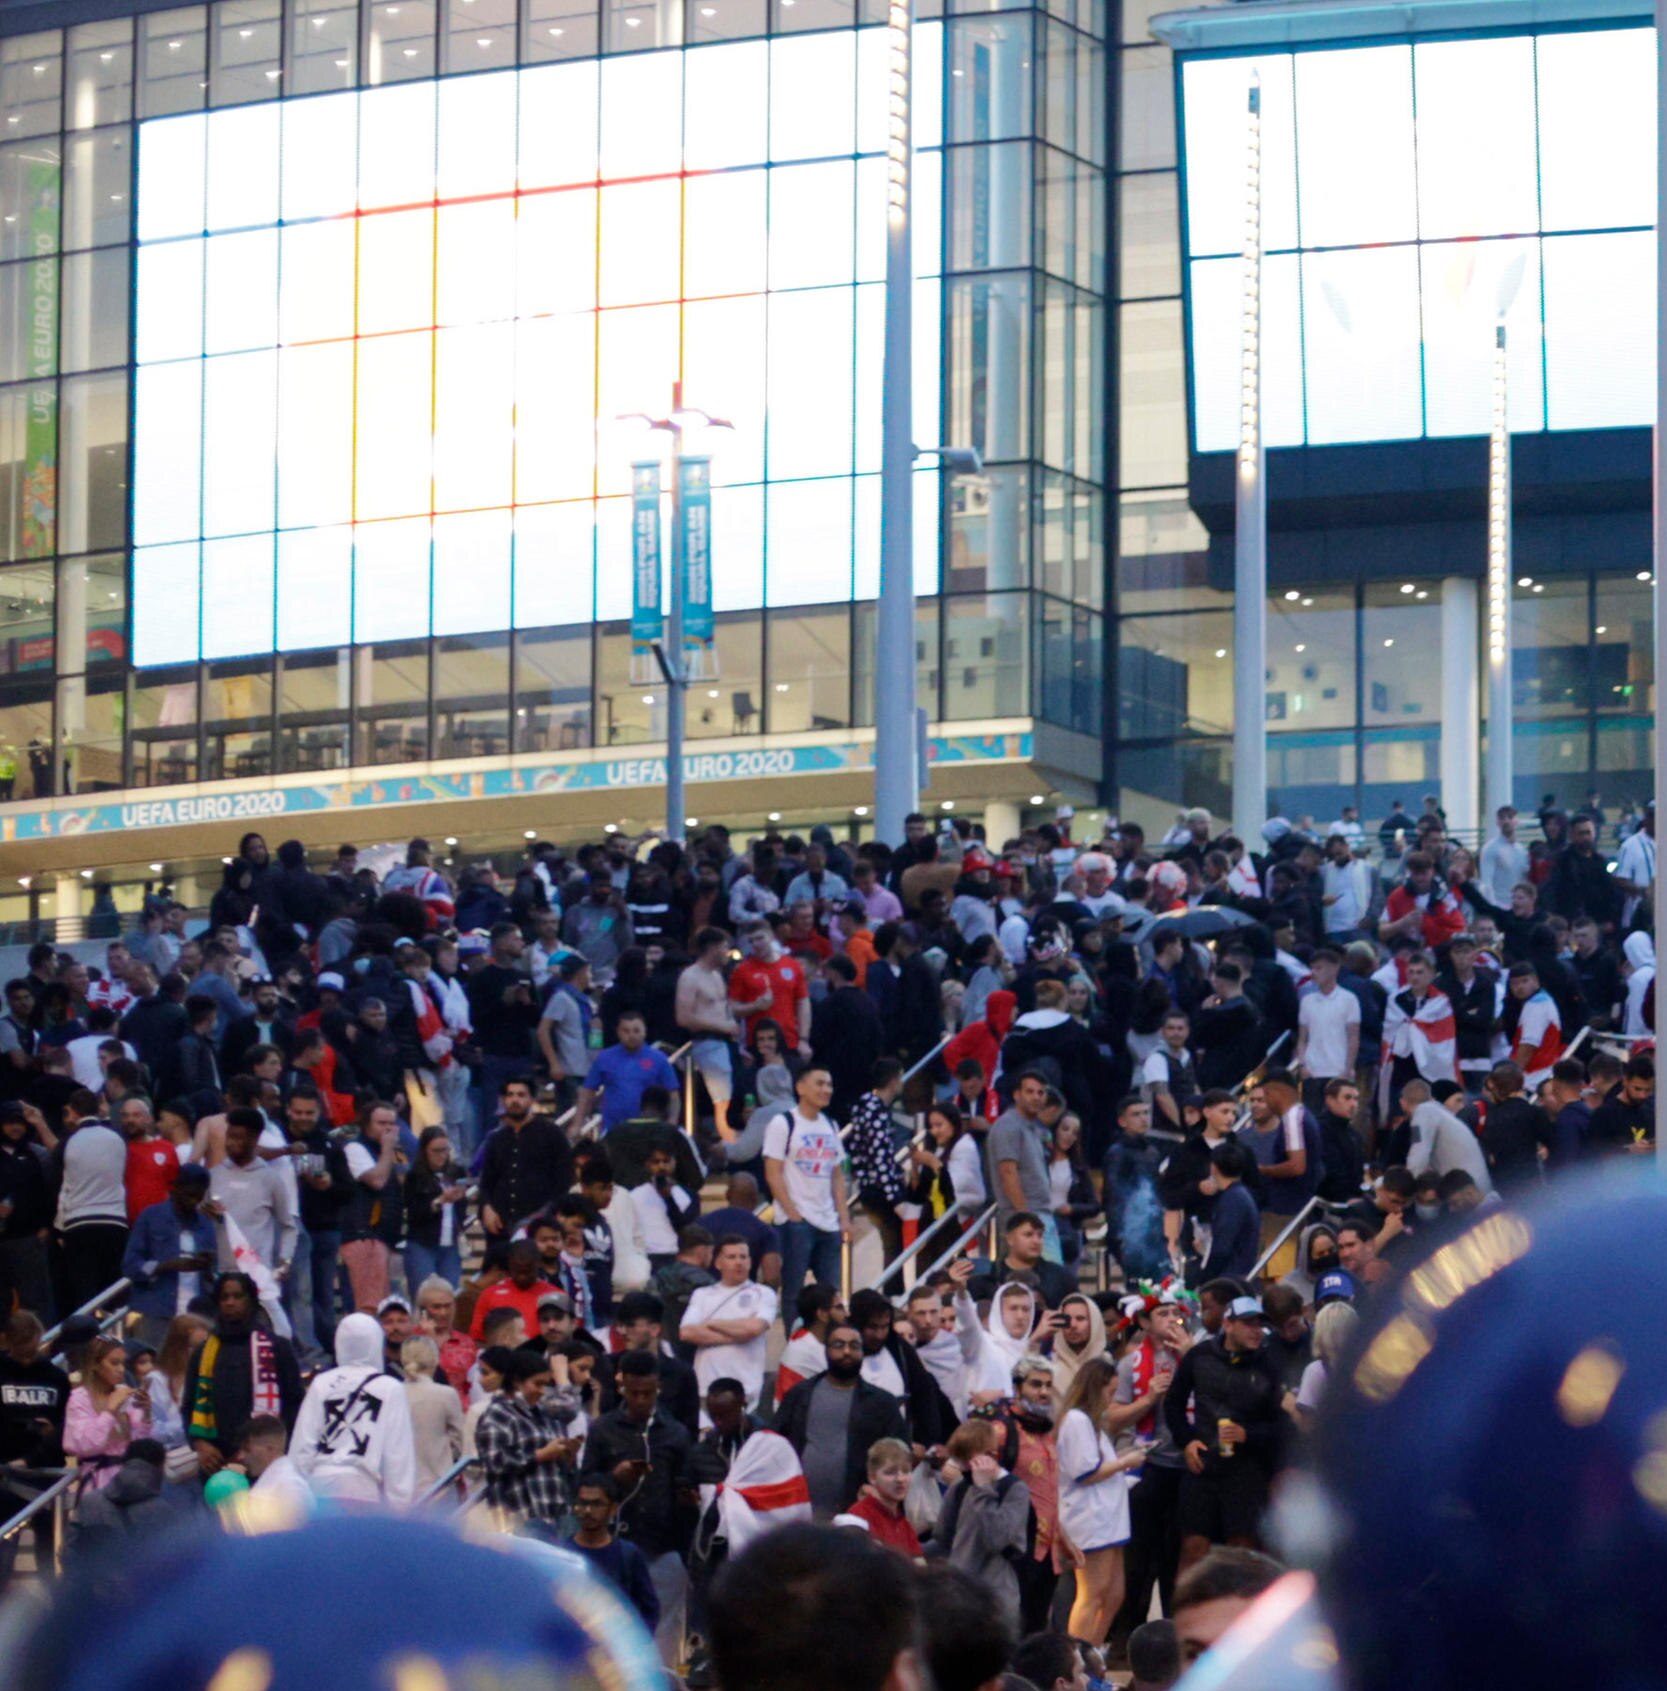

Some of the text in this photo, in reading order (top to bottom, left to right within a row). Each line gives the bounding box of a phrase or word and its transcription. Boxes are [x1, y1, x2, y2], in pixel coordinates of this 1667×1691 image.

[33, 295, 52, 359] EURO
[606, 749, 795, 785] UEFA URO 2020
[122, 791, 286, 827] UEFA EURO 2020
